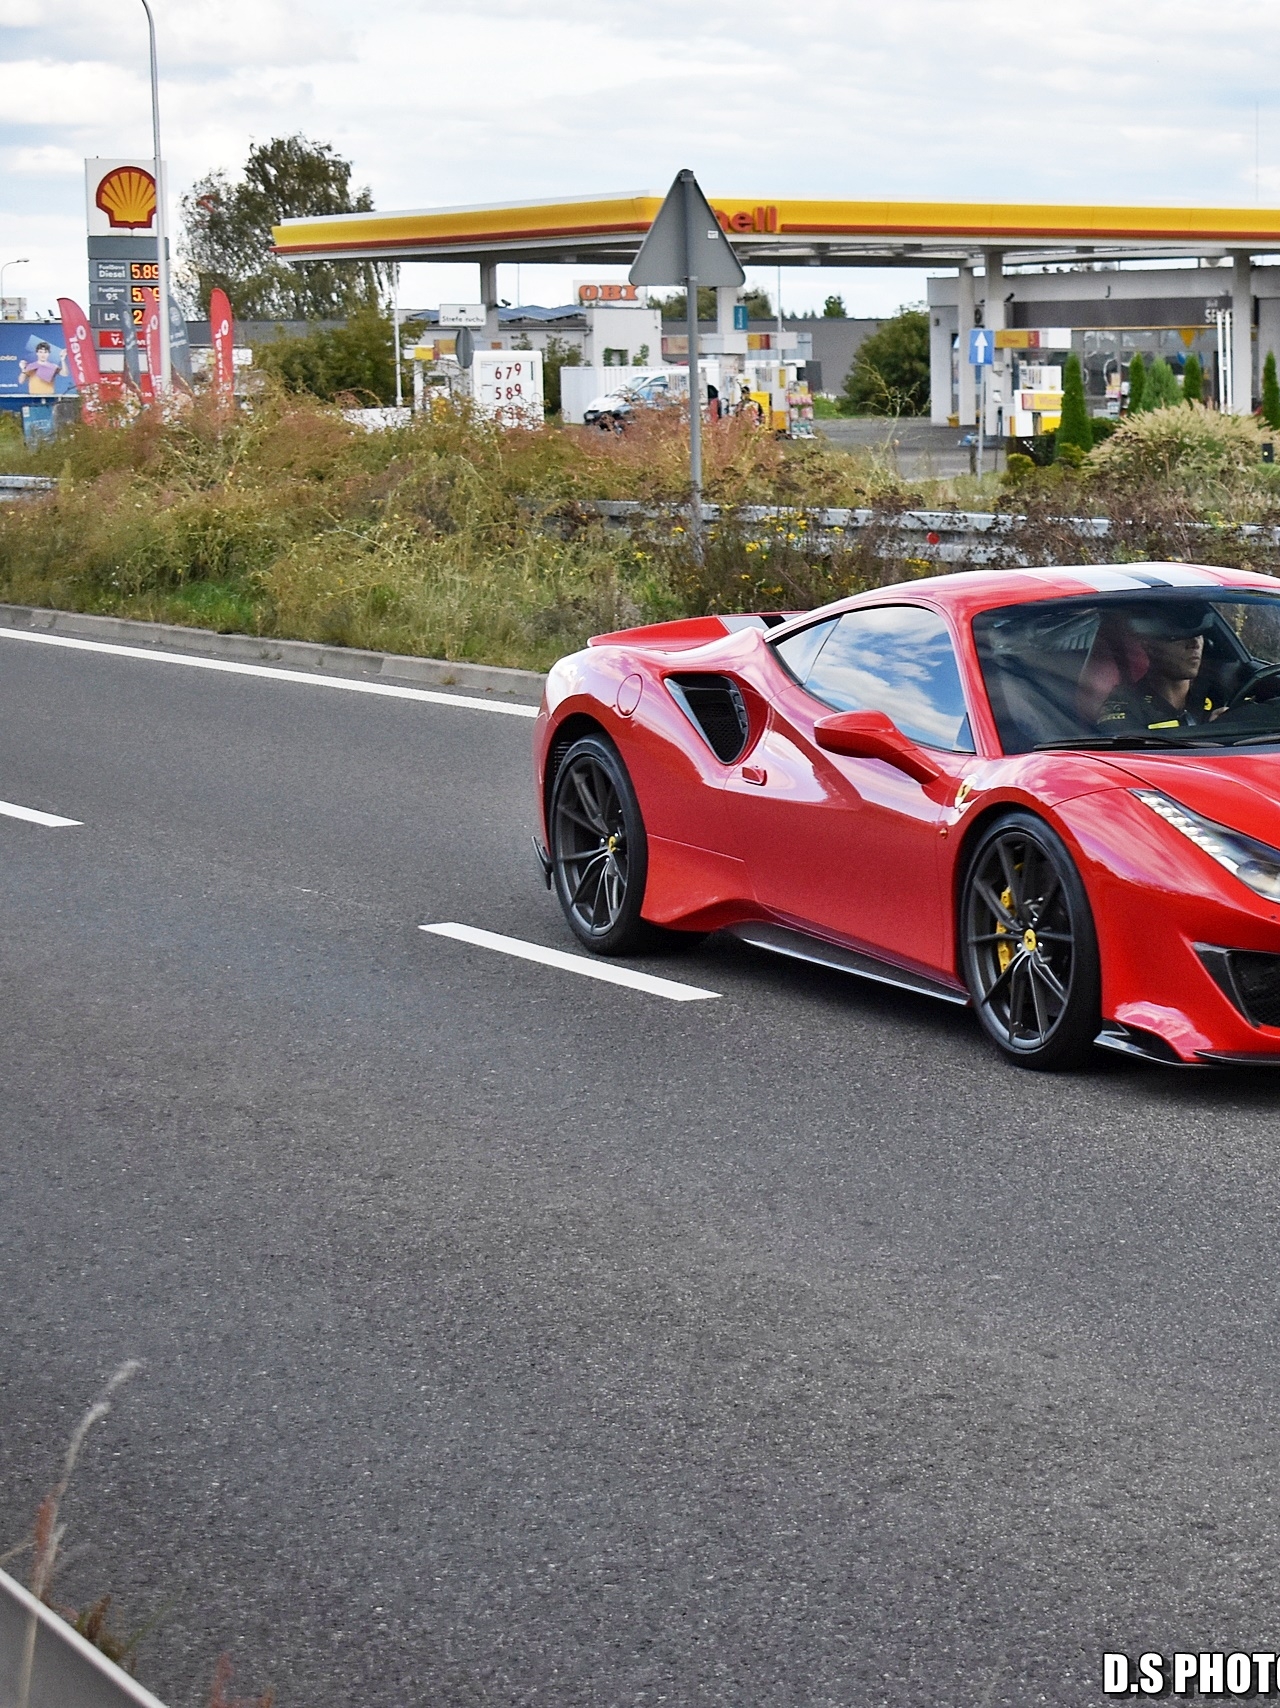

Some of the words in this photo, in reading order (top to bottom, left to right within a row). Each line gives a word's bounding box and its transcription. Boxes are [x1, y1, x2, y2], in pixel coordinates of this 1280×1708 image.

[98, 270, 126, 278] Diesel
[131, 263, 158, 279] 5.89
[105, 293, 118, 301] 95
[132, 287, 160, 302] 5.9
[579, 285, 639, 301] OBI
[495, 363, 521, 380] 679
[495, 383, 521, 400] 589
